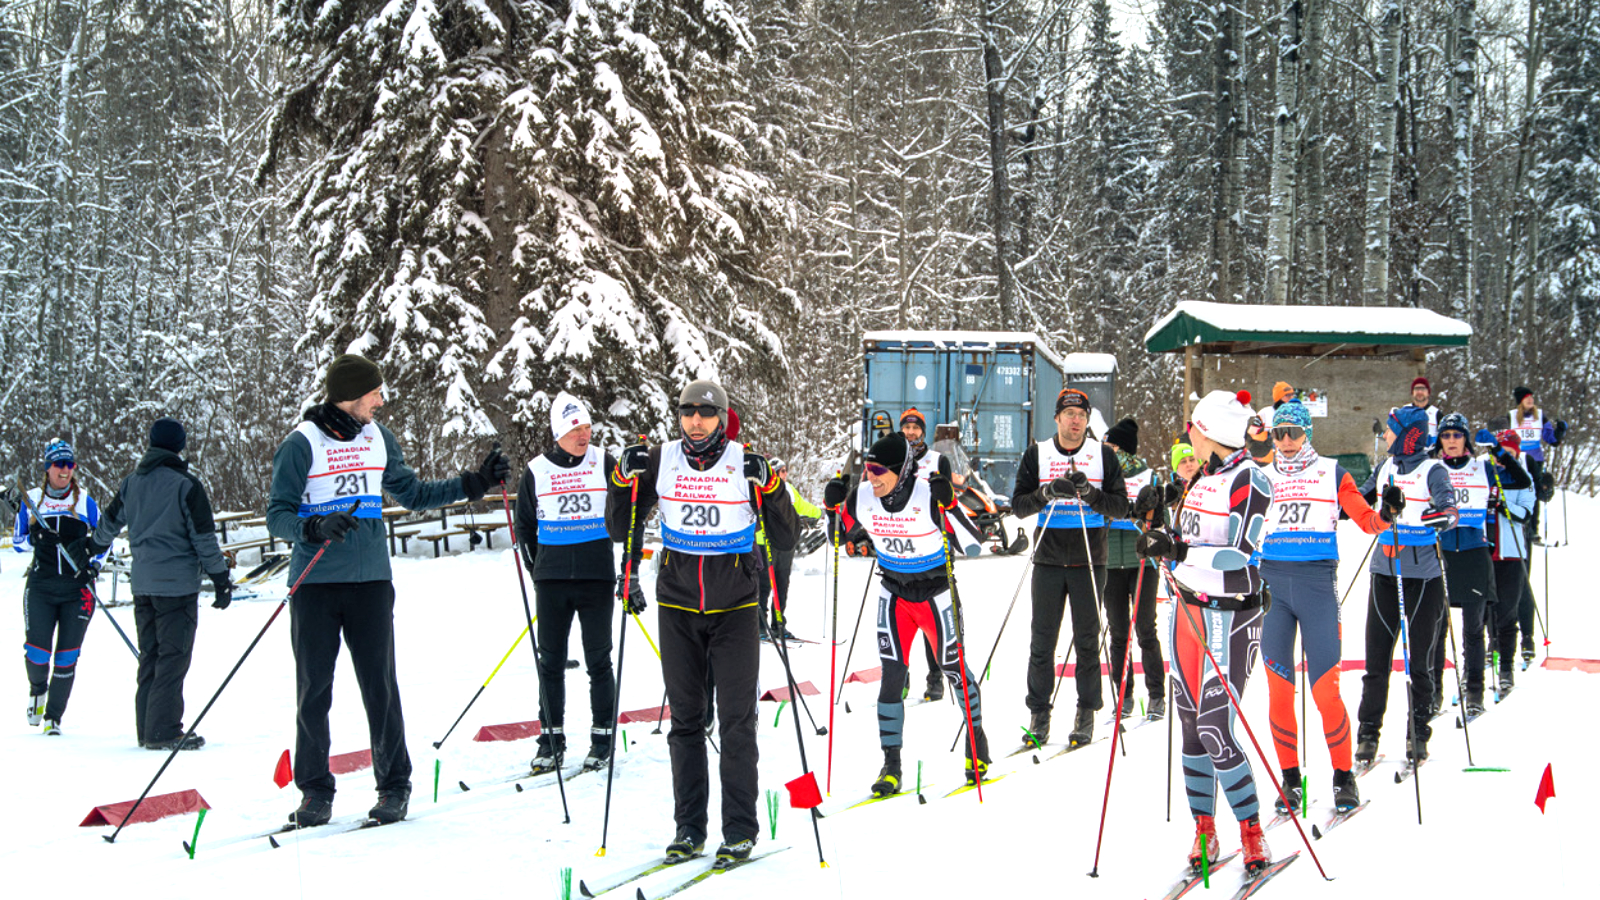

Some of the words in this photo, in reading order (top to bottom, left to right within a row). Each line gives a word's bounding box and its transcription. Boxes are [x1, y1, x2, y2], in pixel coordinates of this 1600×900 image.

[326, 446, 371, 456] CANADIAN
[328, 454, 360, 463] PACIFIC
[328, 461, 365, 471] RAILWAY
[550, 470, 592, 480] CANADIAN
[676, 475, 728, 483] CANADIAN
[334, 472, 368, 497] 231
[551, 478, 582, 486] PACIFIC
[675, 483, 714, 491] PACIFIC
[558, 493, 592, 514] 233
[680, 504, 720, 527] 230
[1278, 502, 1312, 524] 237
[1182, 510, 1200, 538] 236
[882, 538, 916, 554] 204
